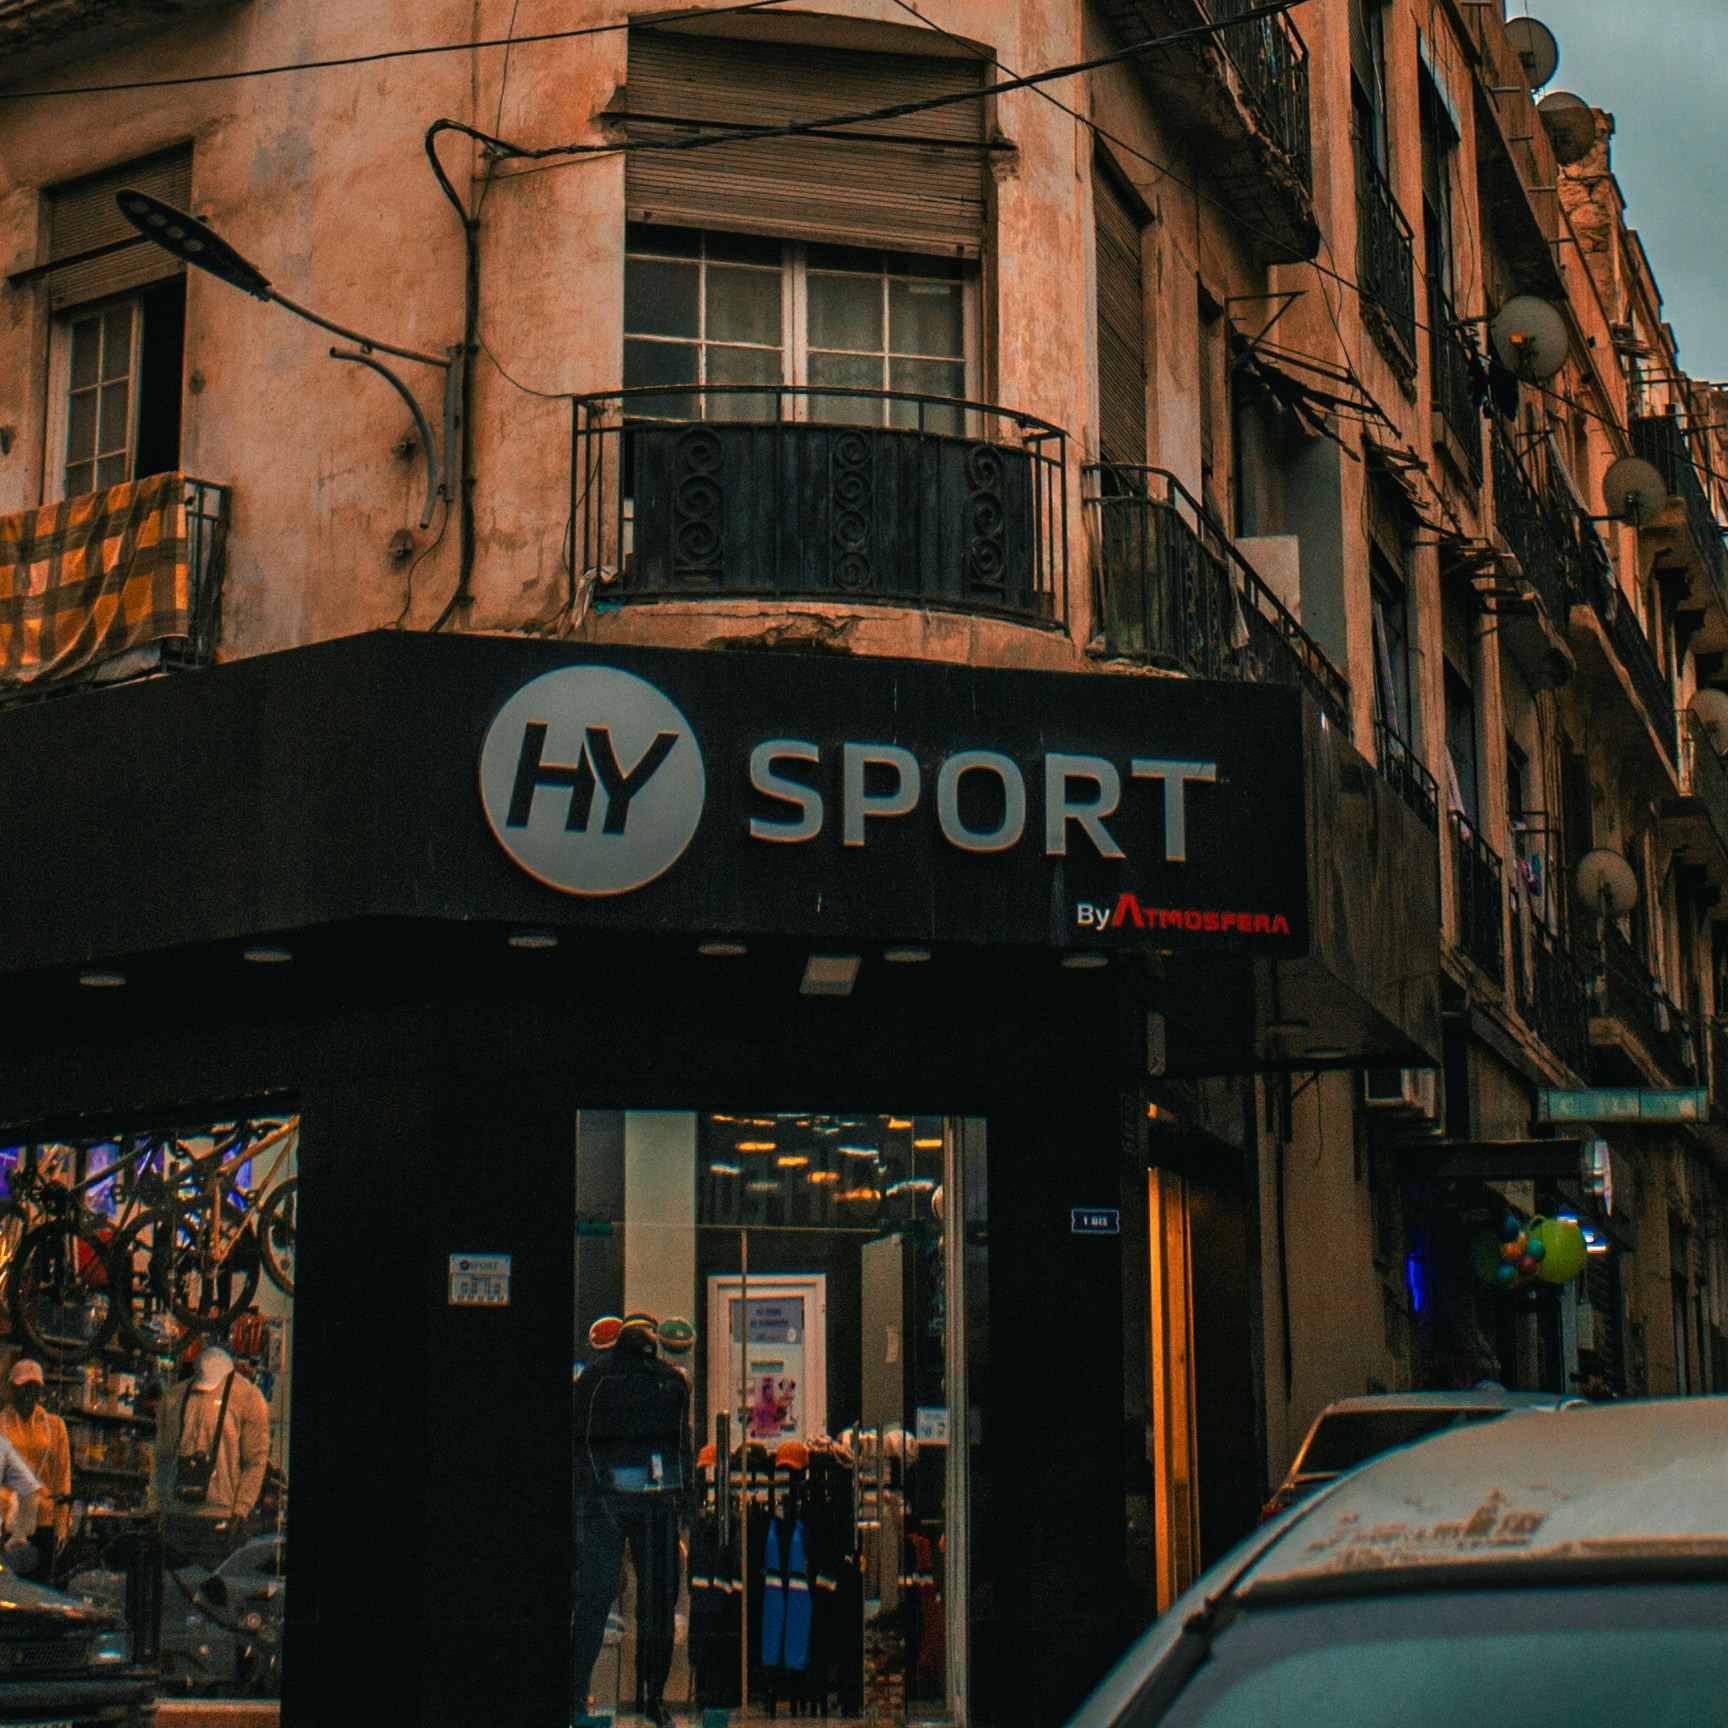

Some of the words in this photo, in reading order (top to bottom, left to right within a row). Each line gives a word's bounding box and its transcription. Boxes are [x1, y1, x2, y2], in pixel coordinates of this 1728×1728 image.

[505, 719, 681, 837] HY
[747, 737, 1219, 864] SPORT
[1076, 902, 1111, 932] By
[1113, 892, 1291, 935] ATMOSFERA
